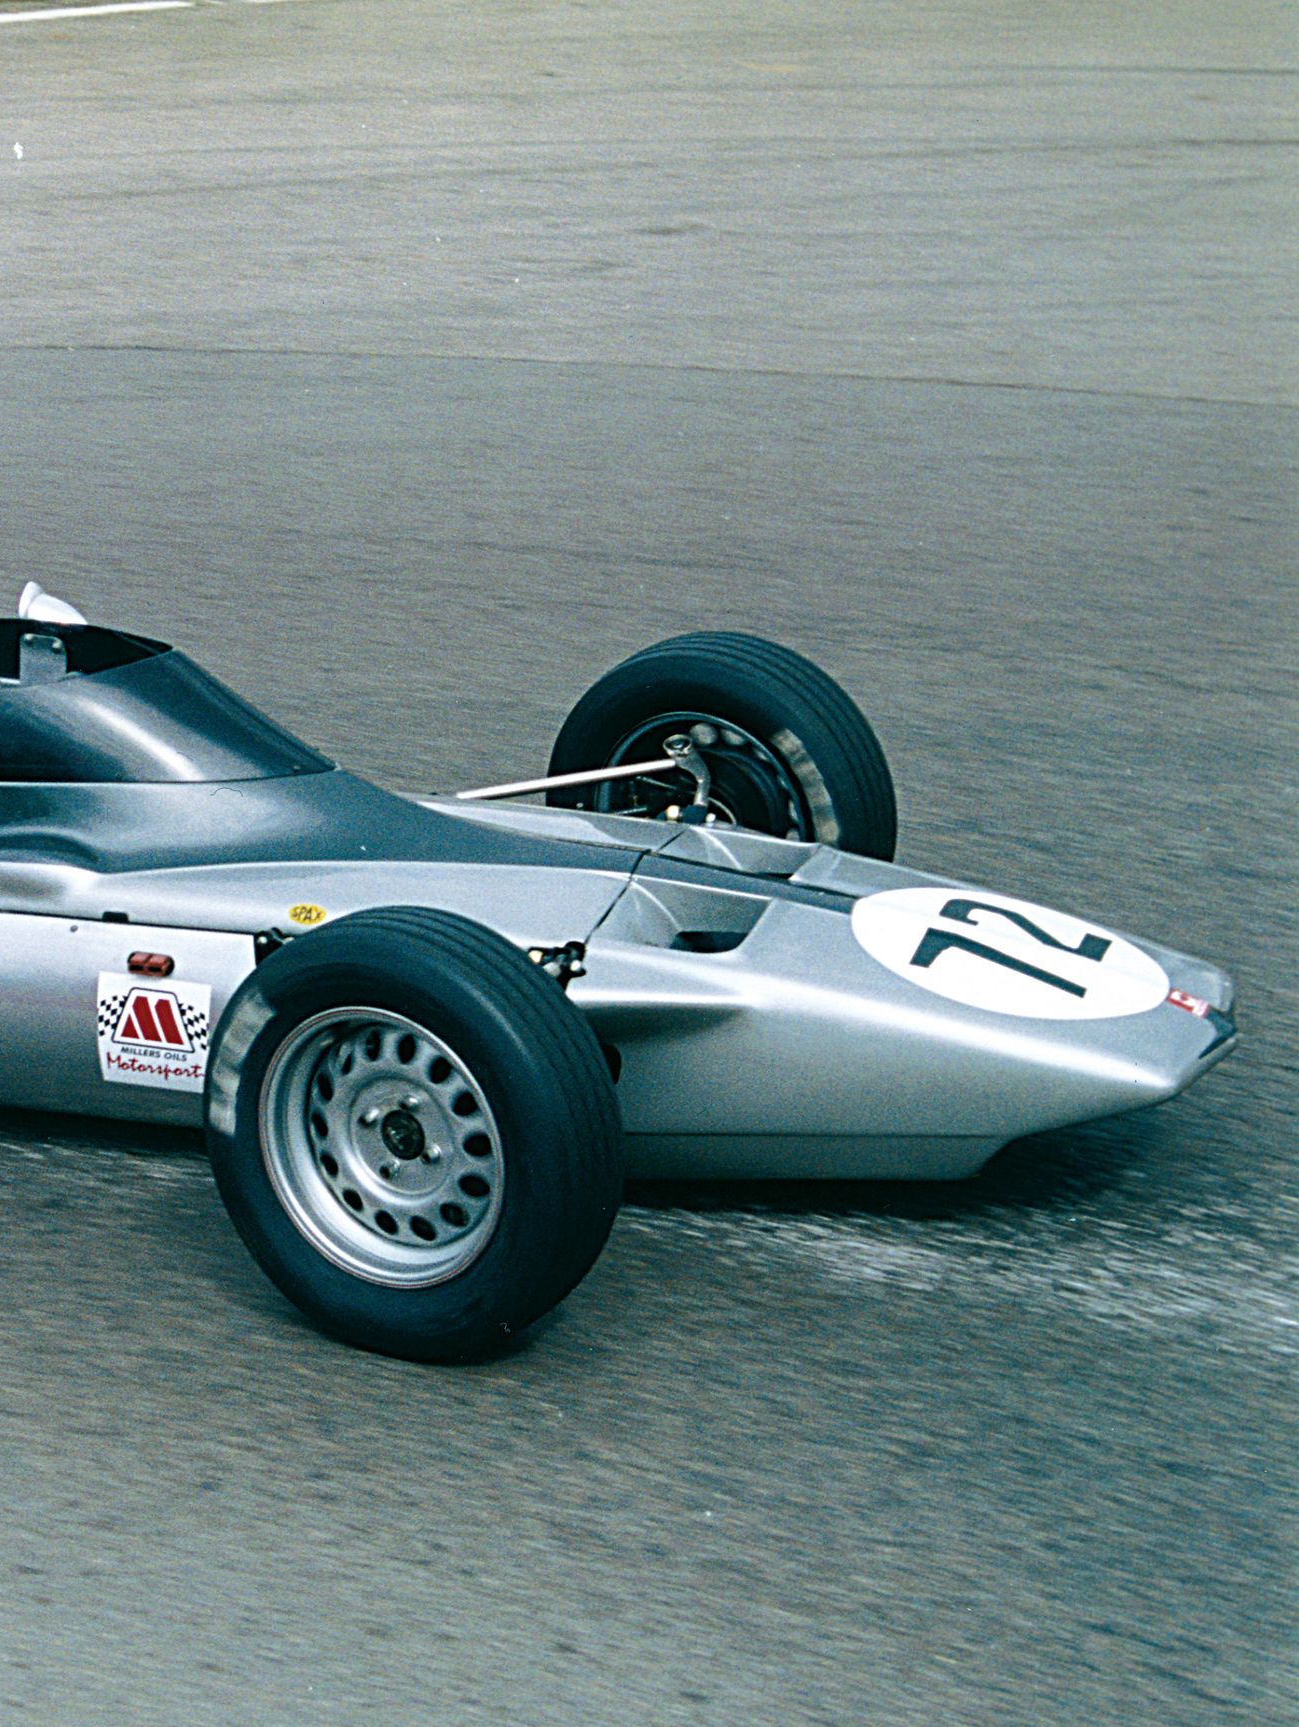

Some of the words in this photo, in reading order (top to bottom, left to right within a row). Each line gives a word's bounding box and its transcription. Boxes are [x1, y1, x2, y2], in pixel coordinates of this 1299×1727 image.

[909, 898, 1112, 998] 72
[106, 1052, 205, 1080] Motorsport
[121, 1046, 160, 1058] MILLERS
[164, 1052, 187, 1062] OILS
